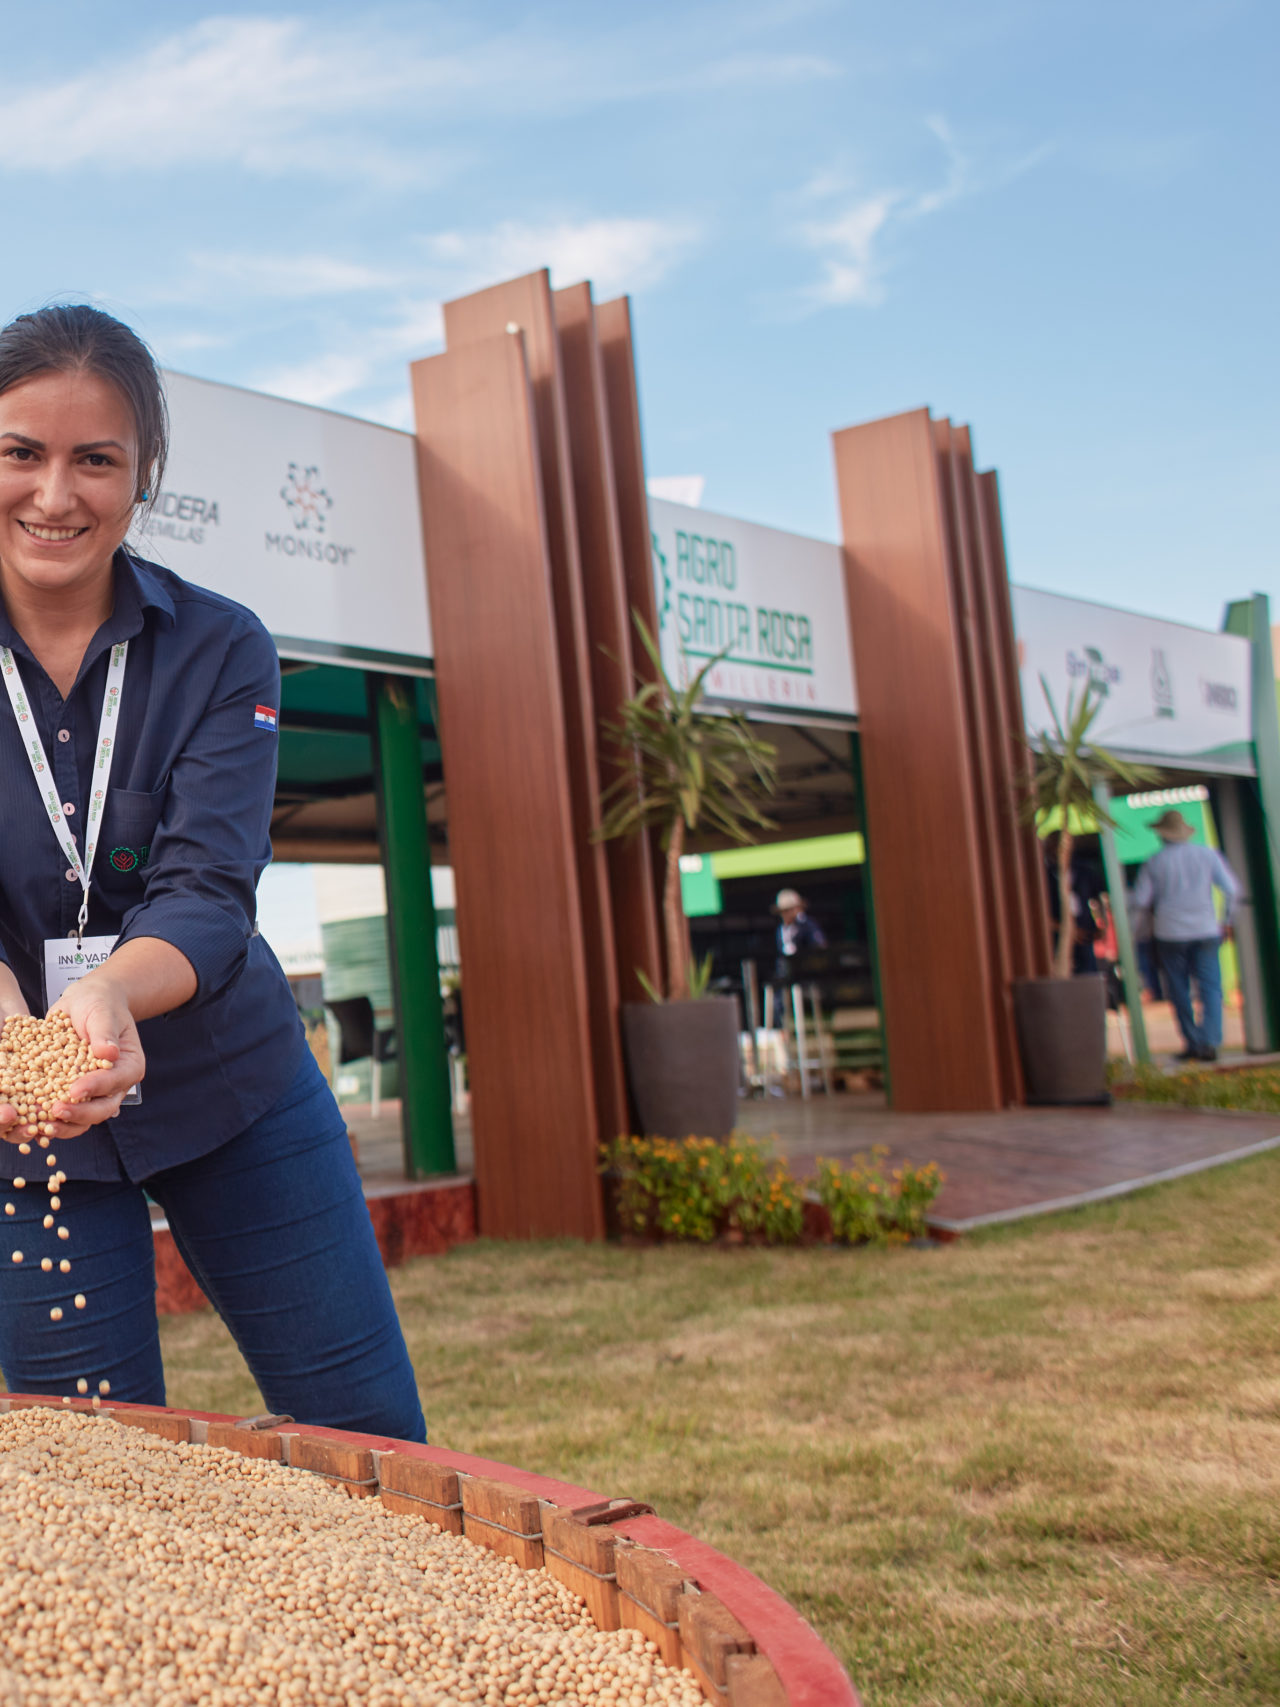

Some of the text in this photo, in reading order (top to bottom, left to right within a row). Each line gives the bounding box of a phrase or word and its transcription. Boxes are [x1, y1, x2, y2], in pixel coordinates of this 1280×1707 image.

[264, 531, 351, 566] MONSOY
[675, 529, 737, 591] AGRO
[677, 591, 812, 661] SANTA ROSA
